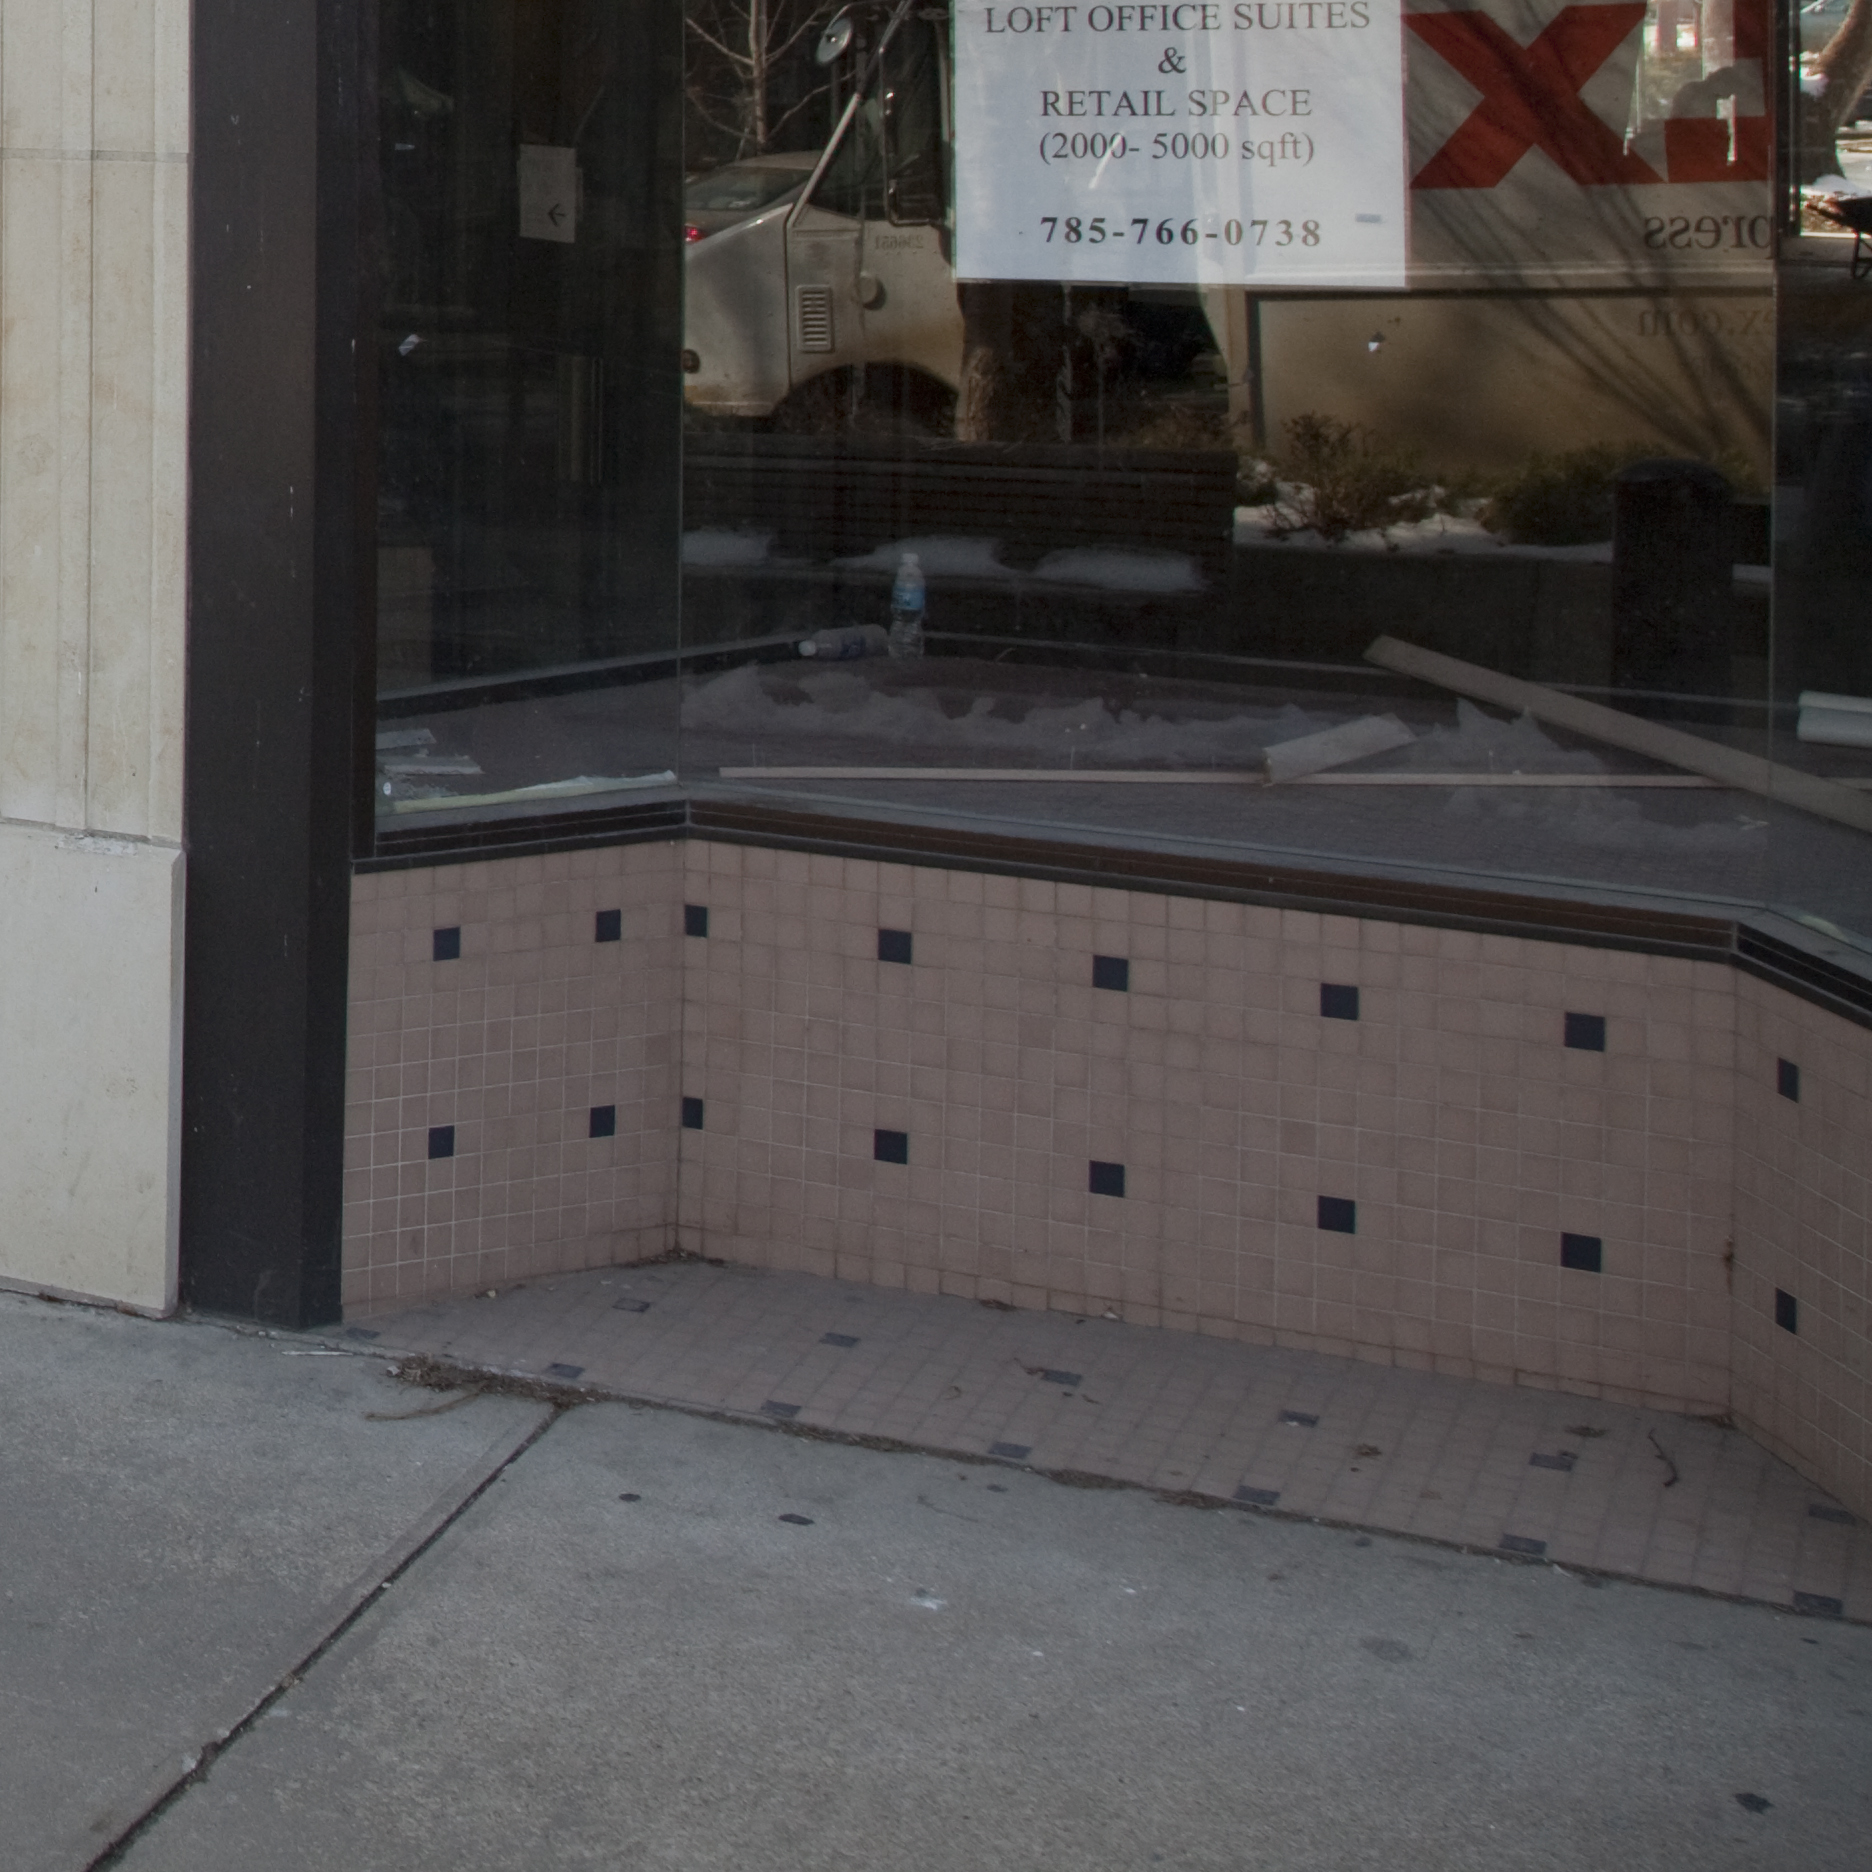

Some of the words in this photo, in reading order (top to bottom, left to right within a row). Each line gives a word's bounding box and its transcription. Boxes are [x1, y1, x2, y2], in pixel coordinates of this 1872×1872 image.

[984, 6, 1077, 33] LOFT
[1087, 3, 1221, 32] OFFICE
[1233, 1, 1371, 30] SUITES
[1158, 47, 1187, 74] &
[1041, 90, 1175, 118] RETAIL
[1188, 89, 1312, 118] SPACE
[1038, 132, 1140, 165] (2000-
[1152, 132, 1229, 159] 5000
[1241, 132, 1315, 167] sqft)
[1041, 217, 1321, 245] 785-766-0738
